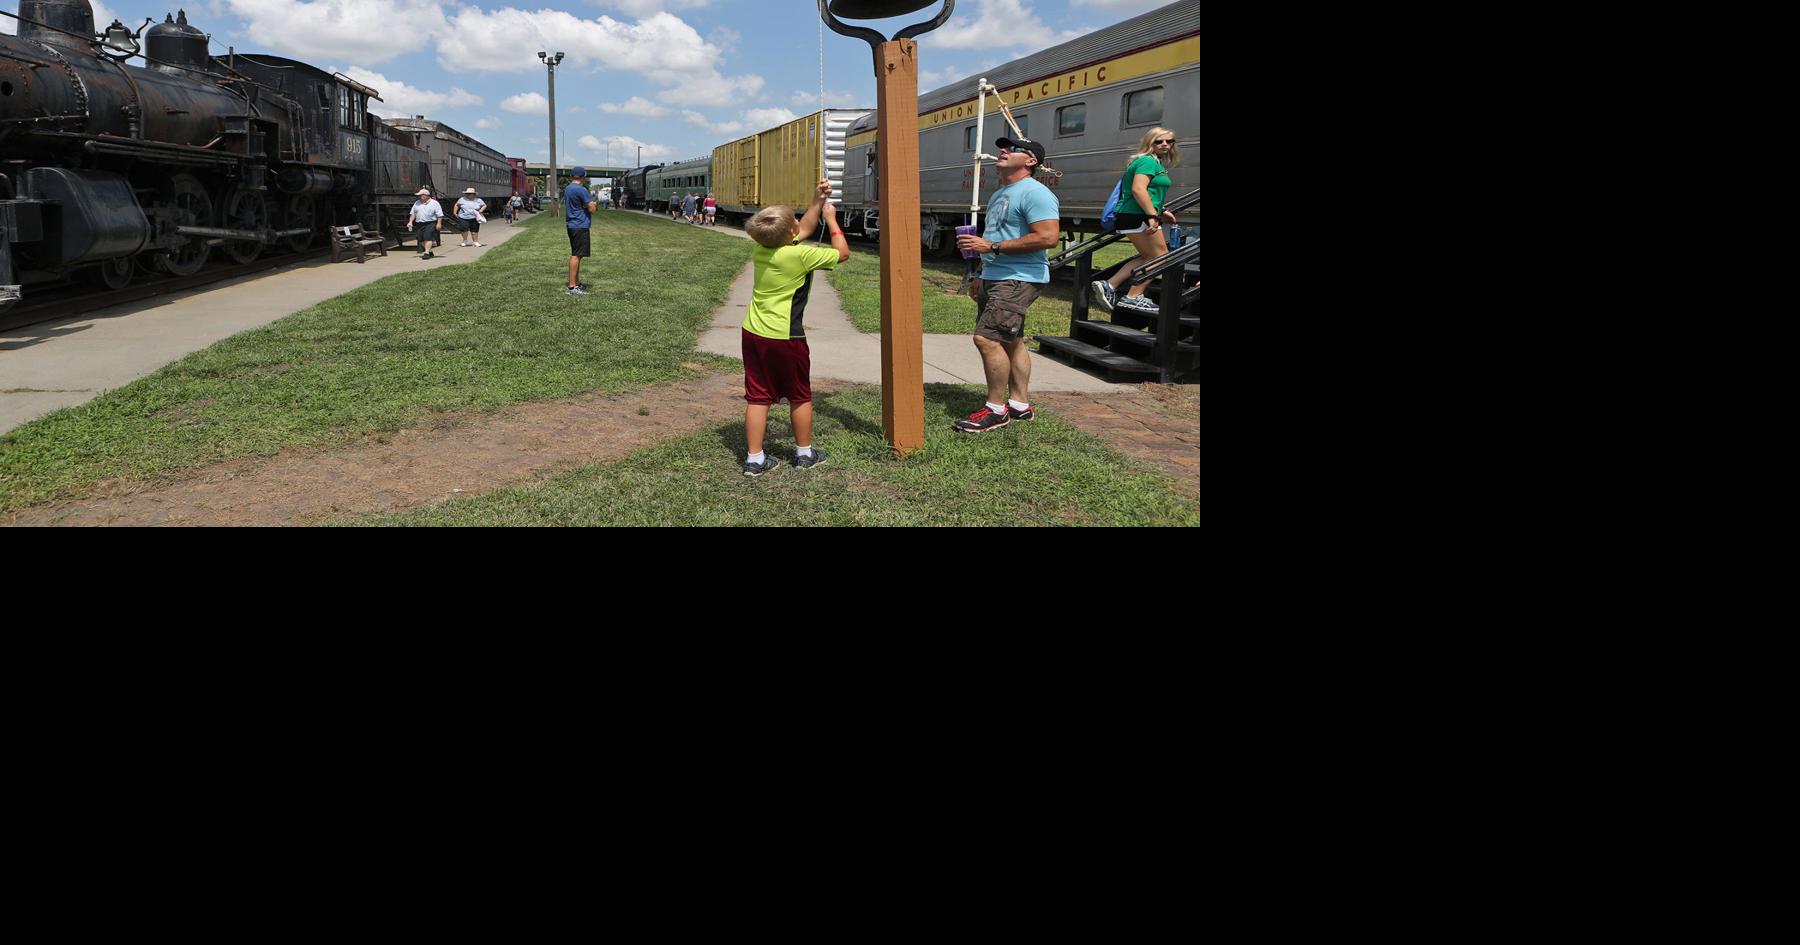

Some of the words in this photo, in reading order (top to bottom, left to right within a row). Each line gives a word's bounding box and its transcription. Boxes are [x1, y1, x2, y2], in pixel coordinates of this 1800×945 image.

[933, 104, 973, 124] UNION
[1013, 66, 1106, 103] PACIFIC
[346, 136, 362, 154] 915
